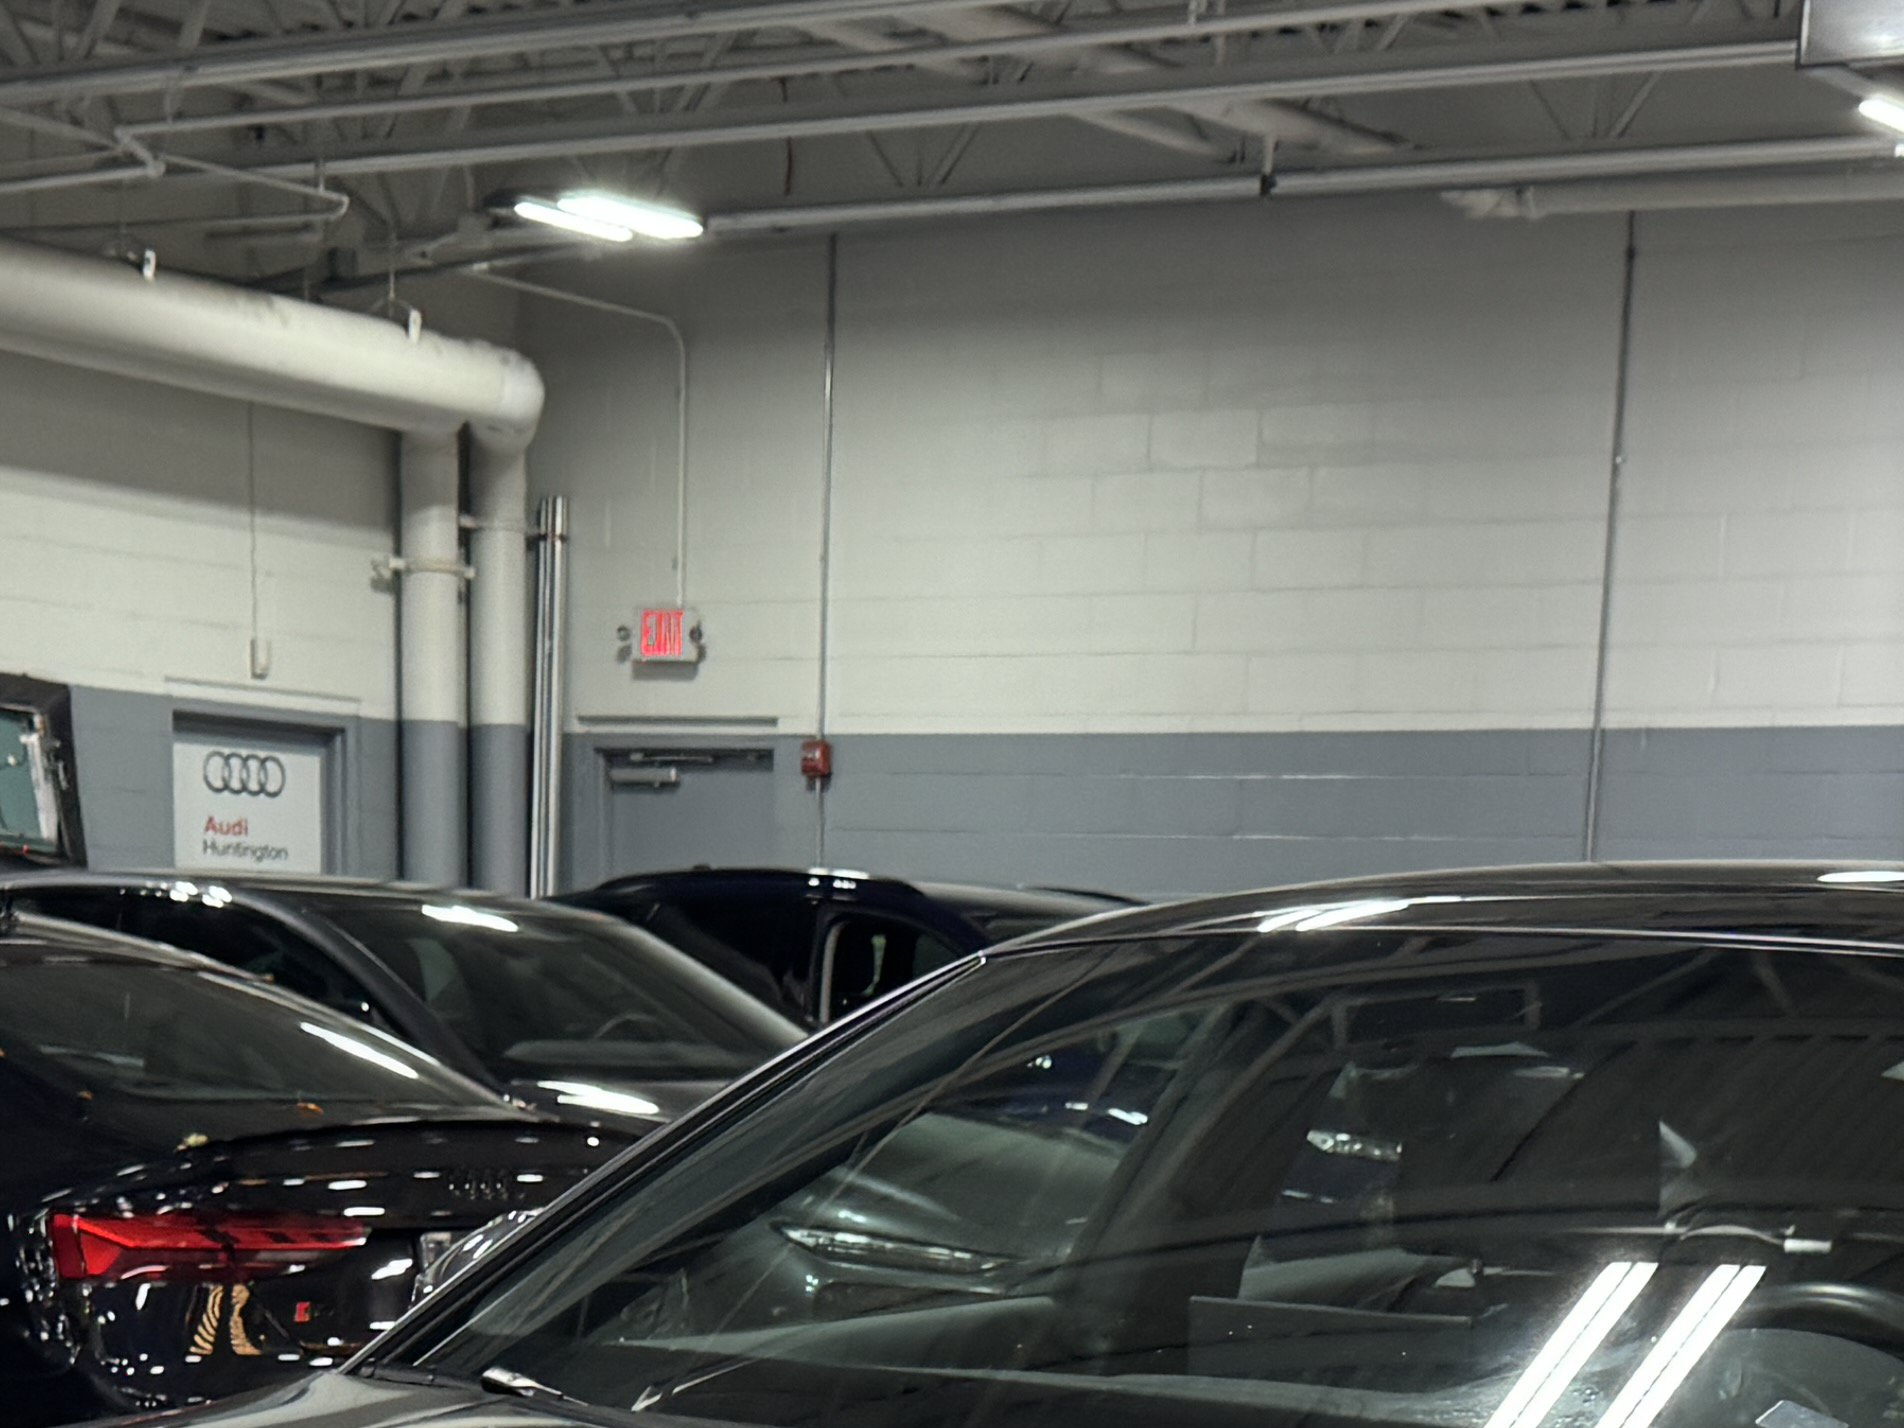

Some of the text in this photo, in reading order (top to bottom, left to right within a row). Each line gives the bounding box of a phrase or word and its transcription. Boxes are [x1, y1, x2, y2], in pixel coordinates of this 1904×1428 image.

[640, 609, 683, 657] EXIT
[204, 815, 249, 837] Audi
[202, 838, 289, 863] Huntington
